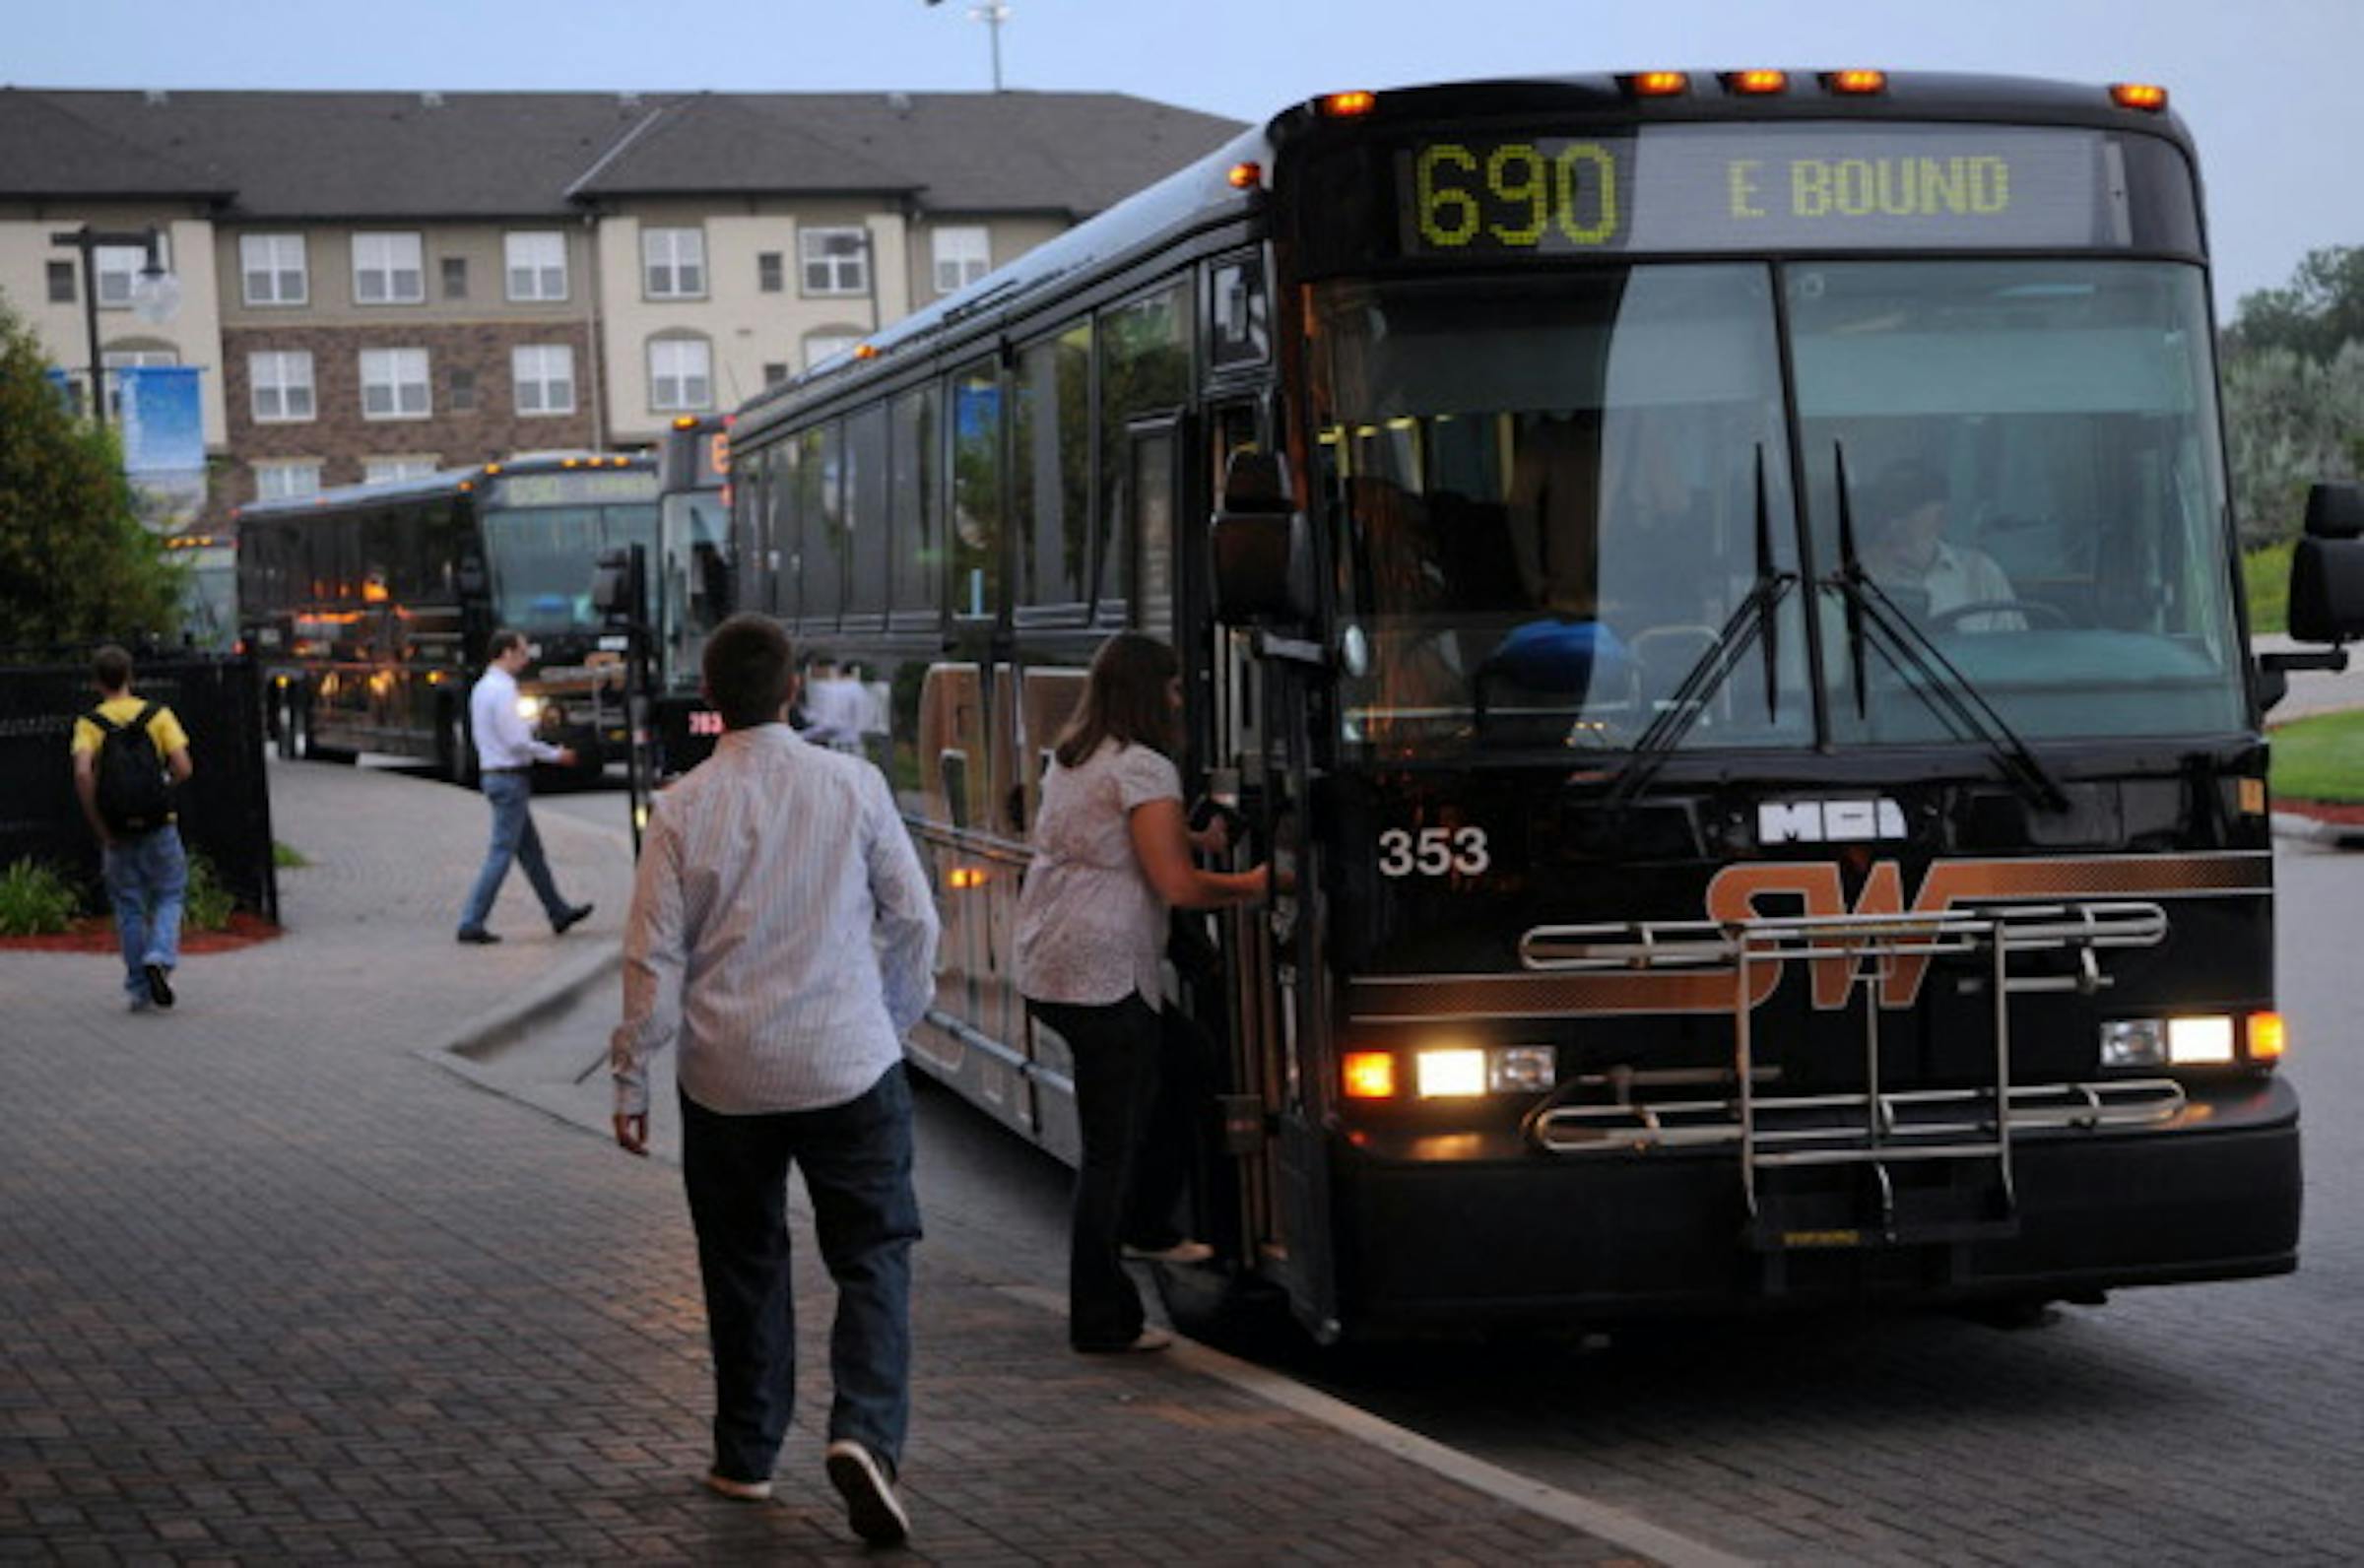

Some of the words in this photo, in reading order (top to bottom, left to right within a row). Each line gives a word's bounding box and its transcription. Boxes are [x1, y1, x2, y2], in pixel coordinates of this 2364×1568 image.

[1417, 144, 1616, 245] 690
[1730, 161, 1765, 219] E
[1792, 156, 2010, 217] BOUND
[1379, 826, 1489, 877] 353
